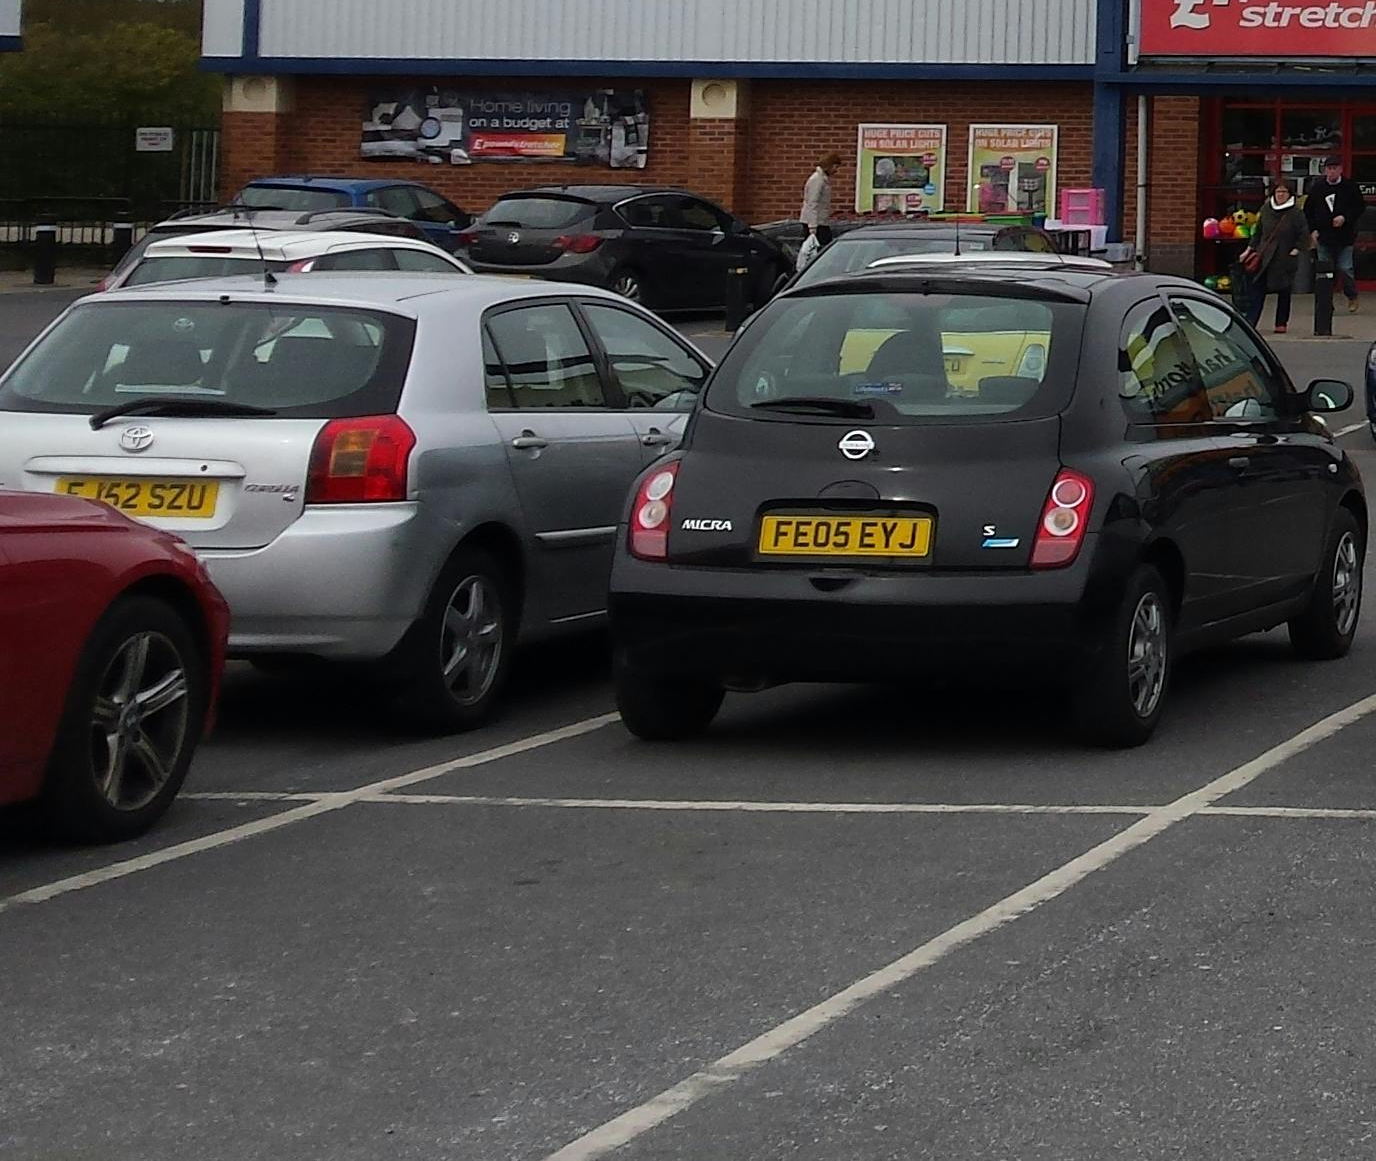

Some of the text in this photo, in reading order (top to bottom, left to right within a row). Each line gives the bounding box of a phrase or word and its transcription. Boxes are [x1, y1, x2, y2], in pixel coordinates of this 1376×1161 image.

[470, 99, 571, 117] Home living
[469, 117, 570, 130] on a budget at
[148, 484, 206, 510] SZU
[682, 519, 732, 531] MICRA
[773, 520, 918, 550] FE05 EYJ
